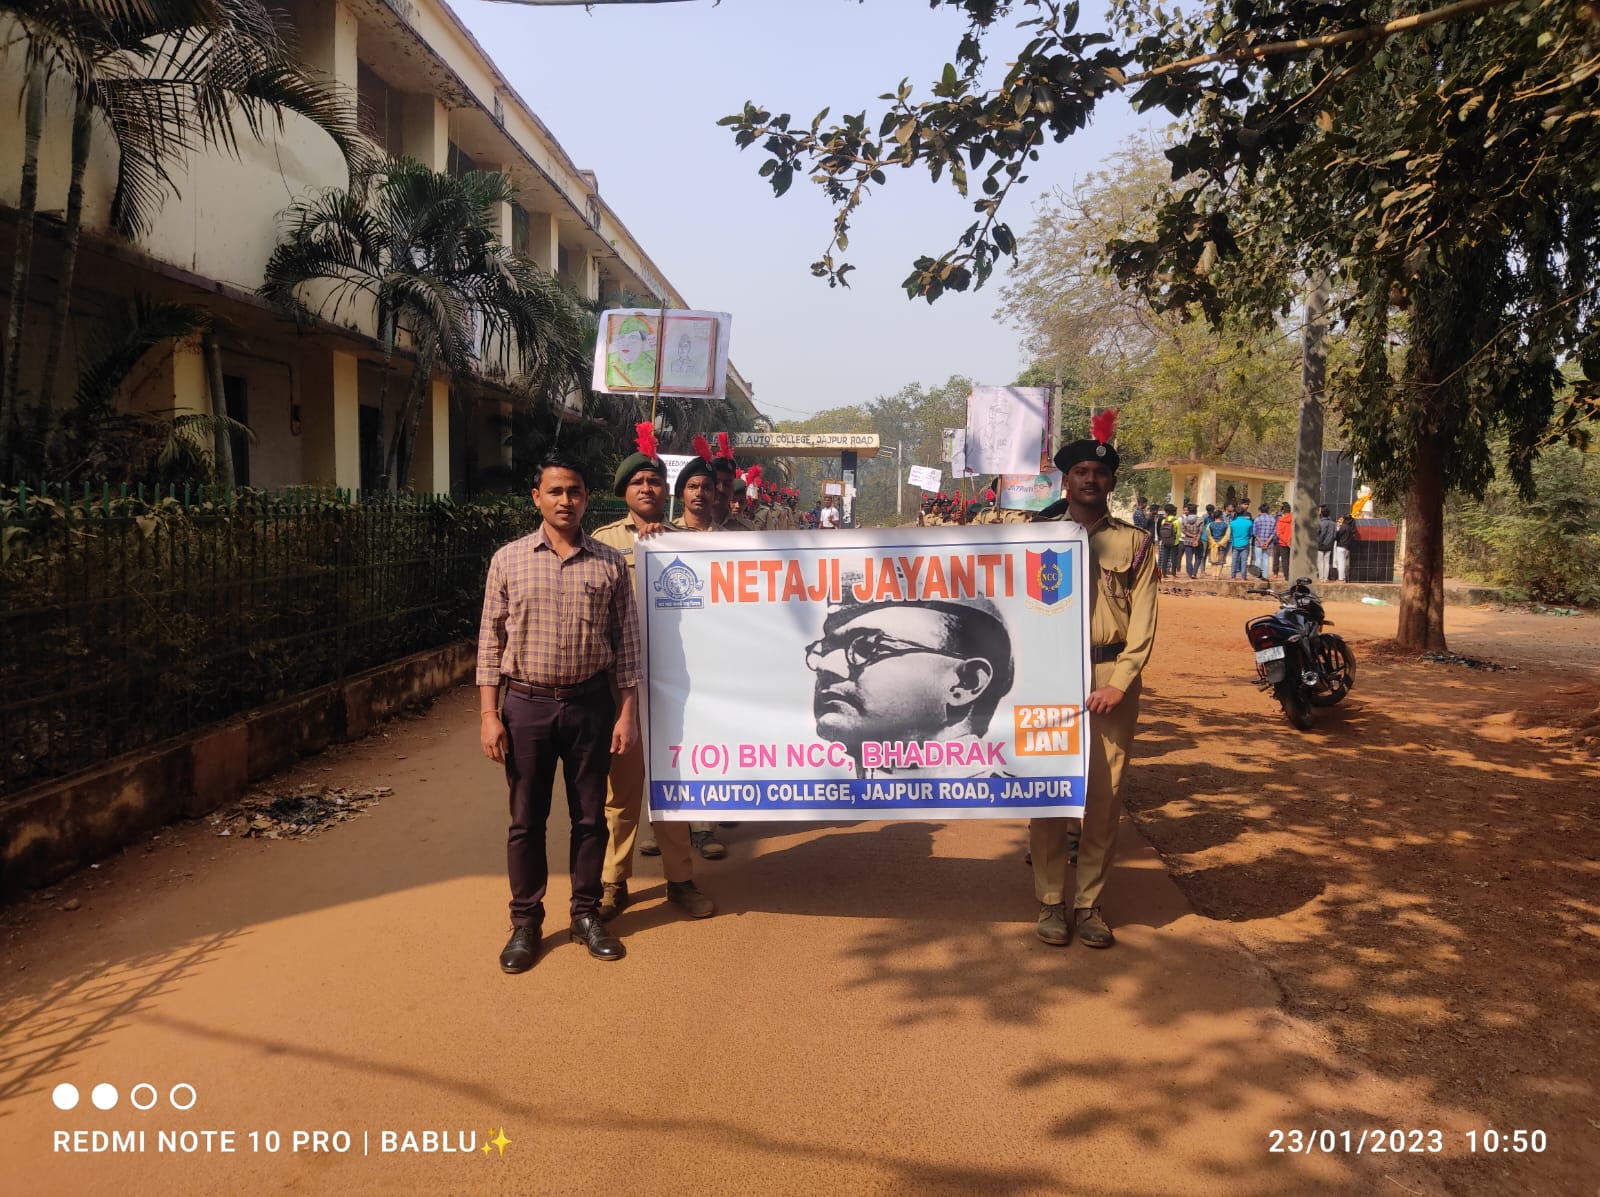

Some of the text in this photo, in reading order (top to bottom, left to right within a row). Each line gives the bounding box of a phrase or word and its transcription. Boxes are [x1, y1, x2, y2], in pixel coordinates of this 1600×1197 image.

[816, 435, 848, 445] JAJPUR
[850, 436, 874, 445] ROAD
[710, 559, 843, 603] NETAJI
[853, 553, 1015, 601] JAYANTI
[1042, 573, 1057, 582] NCC
[1019, 707, 1075, 729] 23RD
[1024, 731, 1068, 752] JAN
[668, 742, 1007, 775] 7 (O) BN NCC, BHADRAK
[662, 780, 1073, 807] V.N. (AUTO) COLLEGE, JAJPUR ROAD, JAJPUR
